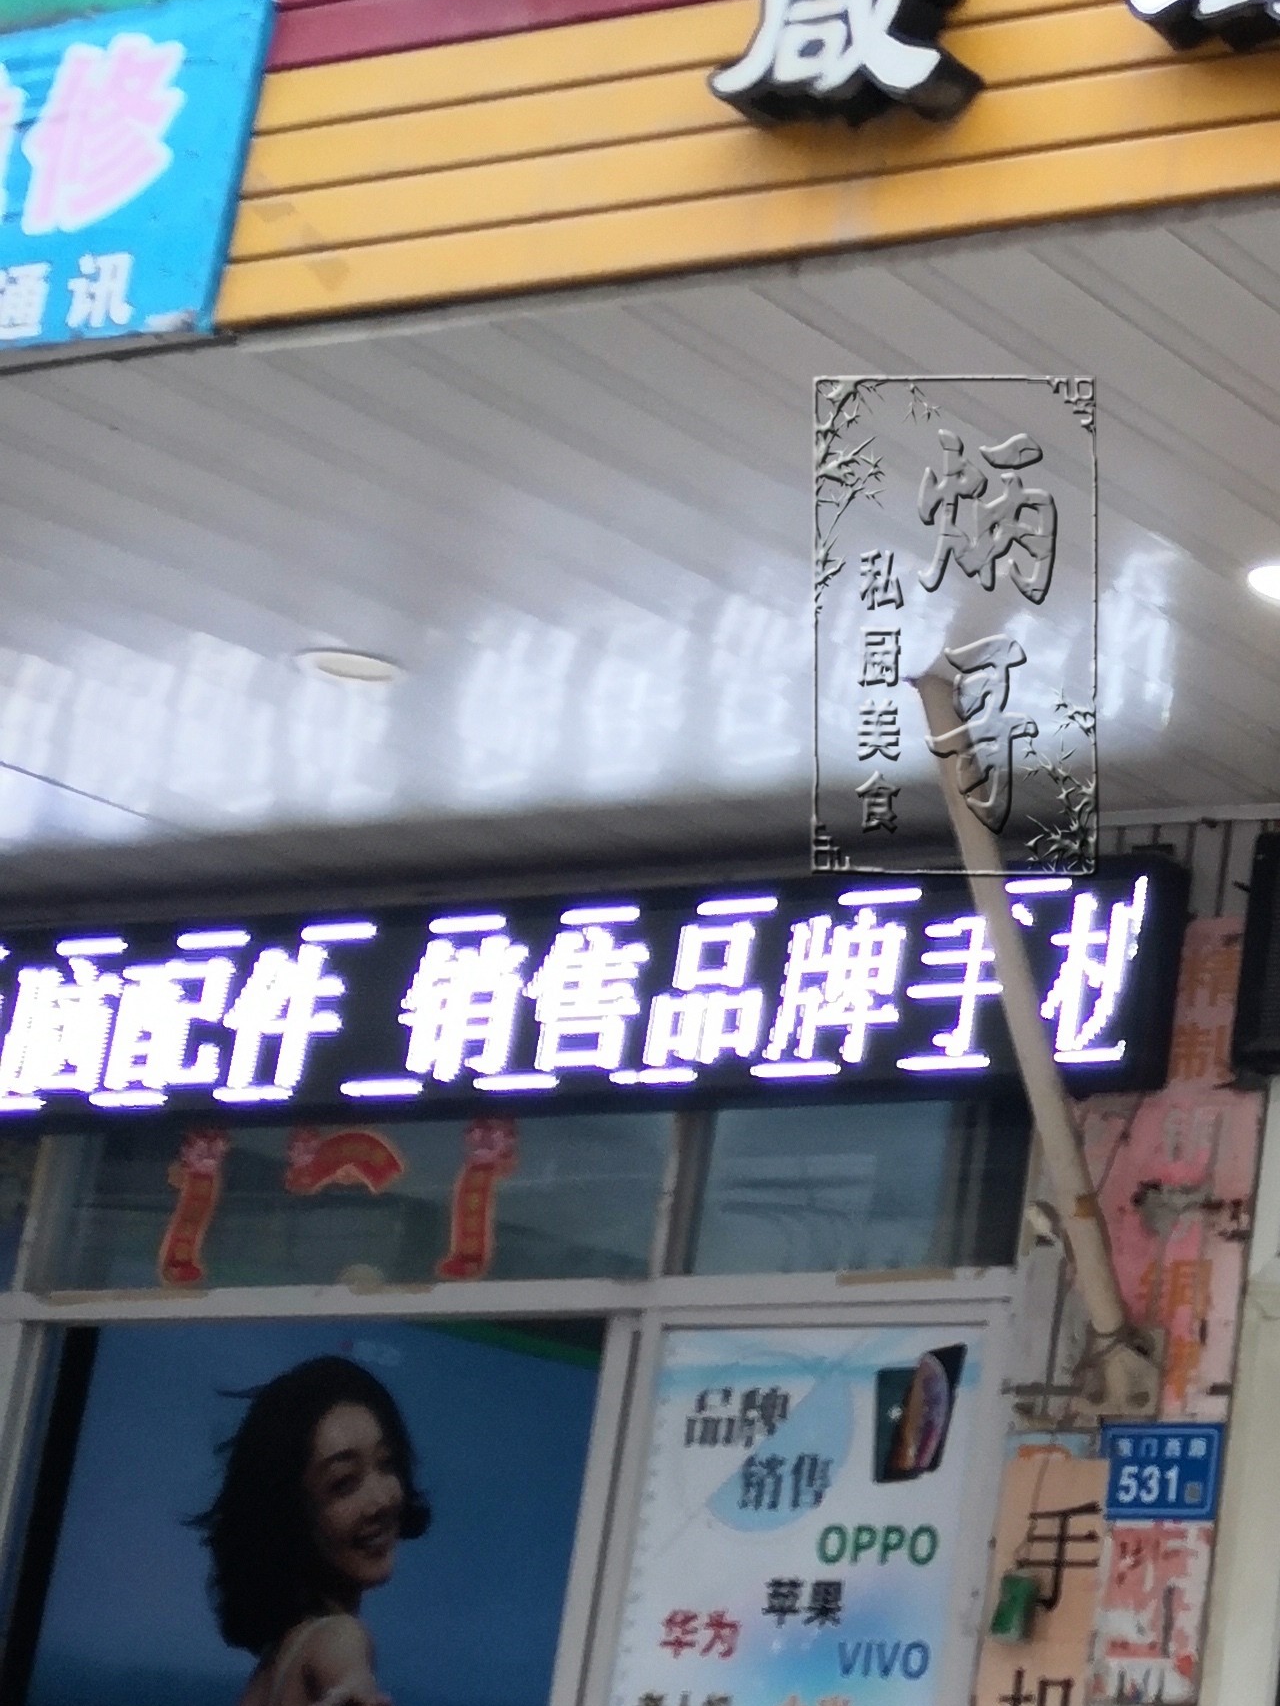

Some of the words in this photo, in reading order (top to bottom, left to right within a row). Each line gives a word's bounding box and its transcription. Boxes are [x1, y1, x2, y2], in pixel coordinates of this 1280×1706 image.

[0, 31, 188, 235] 修
[1115, 1464, 1181, 1504] 531
[816, 1523, 940, 1567] OPPO
[760, 1577, 845, 1628] 苹果
[658, 1608, 743, 1661] 华为
[836, 1639, 931, 1681] VIVO
